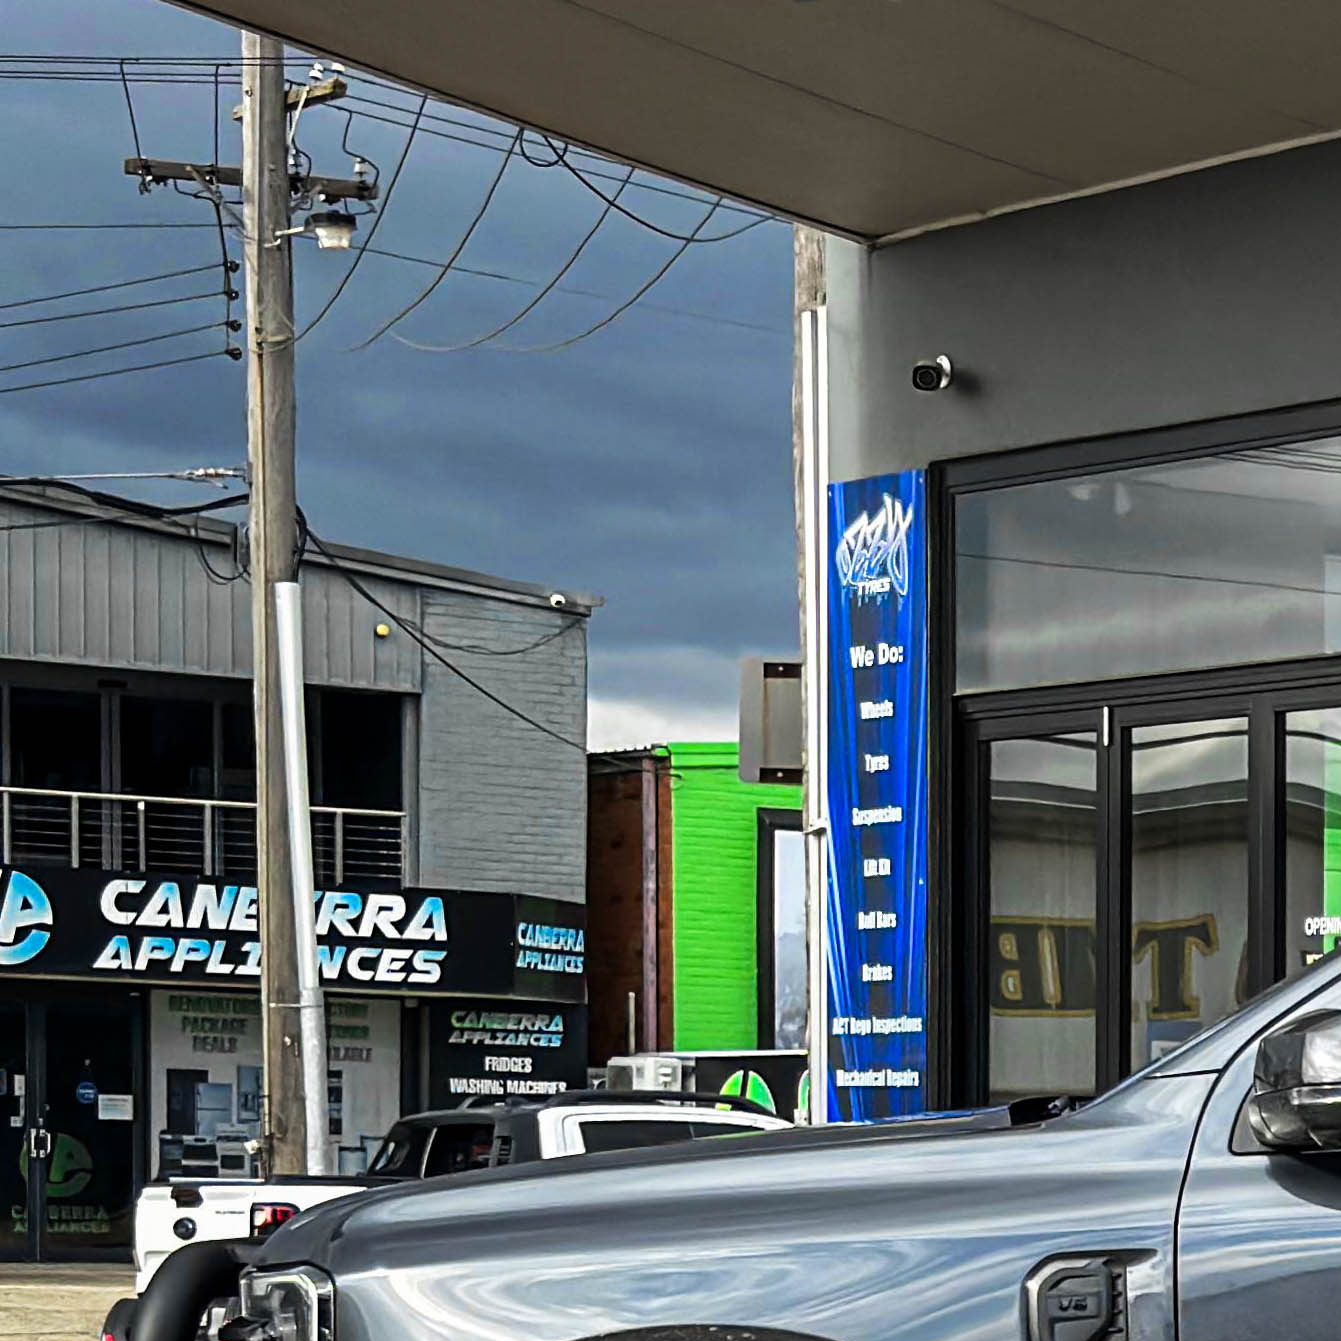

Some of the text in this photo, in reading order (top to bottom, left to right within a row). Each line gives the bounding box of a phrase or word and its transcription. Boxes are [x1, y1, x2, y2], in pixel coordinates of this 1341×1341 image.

[849, 642, 904, 669] We Do:
[860, 699, 894, 720] Wheels
[864, 754, 890, 774] Tyres
[101, 879, 448, 941] CANBRRA
[516, 922, 585, 953] CANBERRA
[92, 935, 448, 984] APPLINCES
[516, 950, 585, 973] APPLIANCES
[862, 963, 893, 982] Brakes
[450, 1011, 564, 1032] CANBERRA
[832, 1017, 850, 1035] ACT
[872, 1015, 923, 1034] Inspections
[448, 1030, 564, 1047] APPLIANCES
[484, 1056, 533, 1073] FRIDGES
[449, 1078, 567, 1095] WASHING MACHINES
[836, 1068, 920, 1088] Mechanical Repairs
